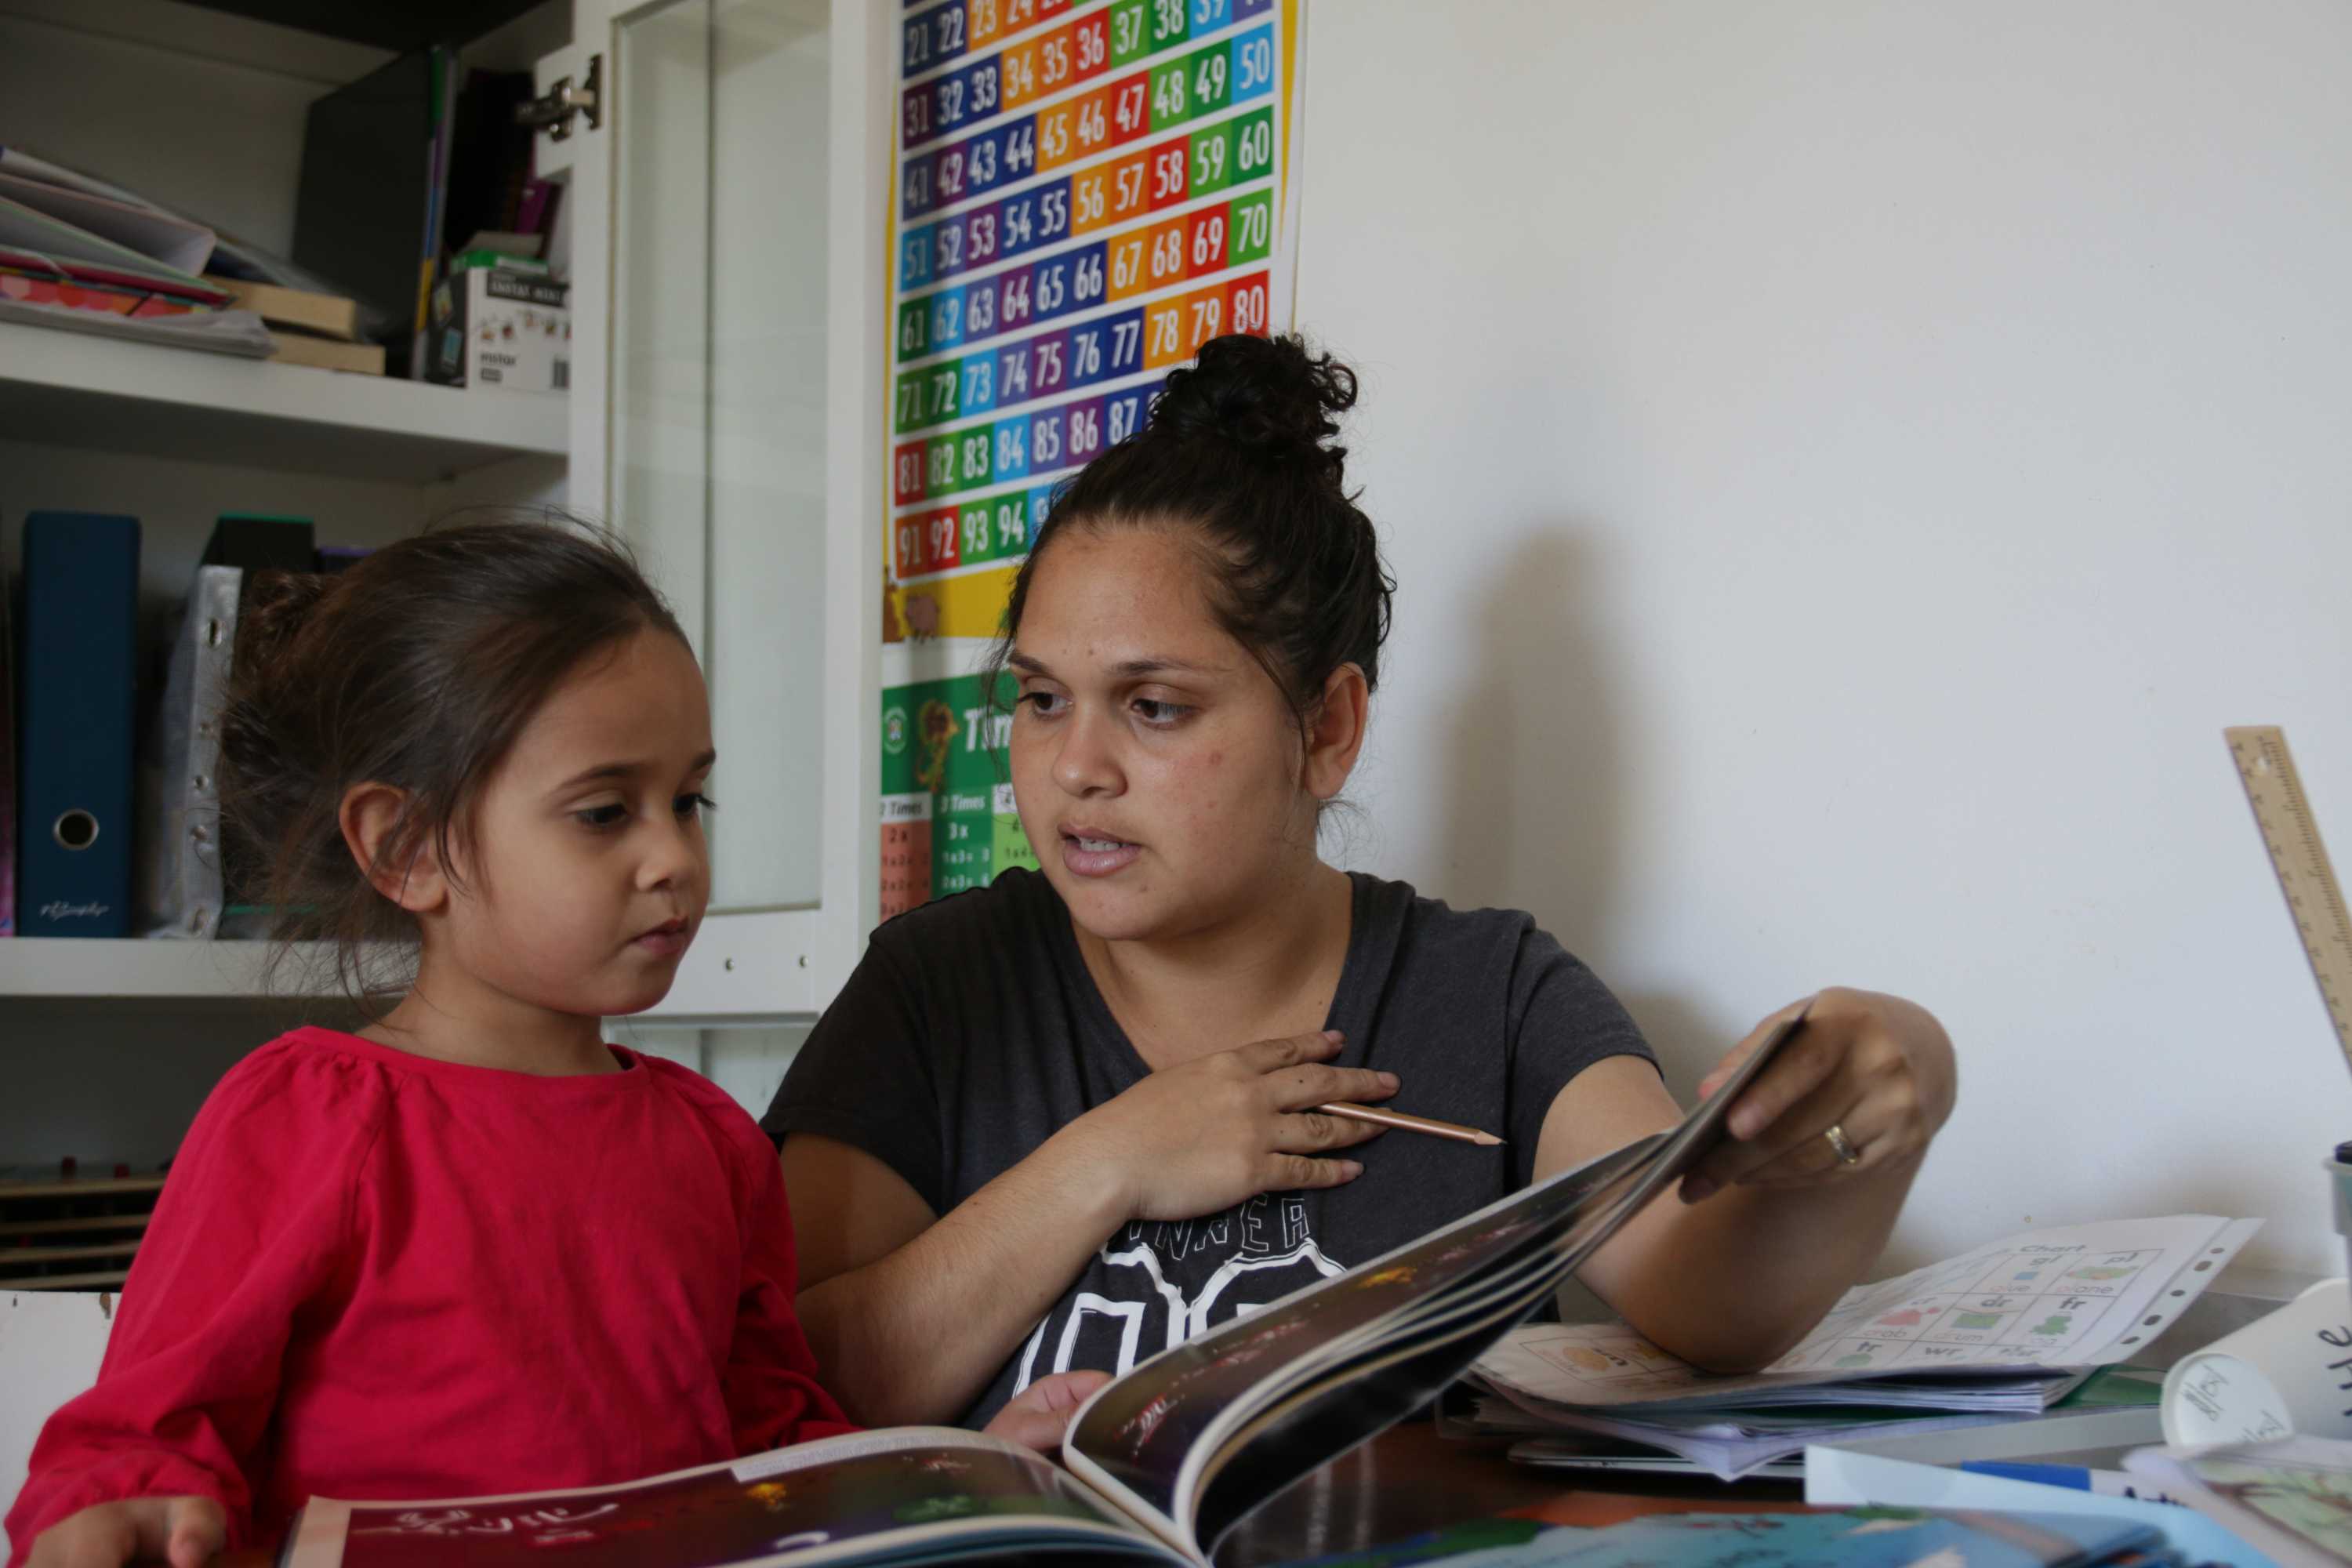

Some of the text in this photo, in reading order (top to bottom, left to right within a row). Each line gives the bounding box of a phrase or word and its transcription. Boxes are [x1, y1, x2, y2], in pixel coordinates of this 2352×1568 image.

[906, 22, 930, 66] 21
[938, 7, 964, 53] 22
[971, 0, 996, 38] 23
[906, 93, 930, 137] 31
[938, 79, 964, 125] 32
[971, 66, 996, 111] 33
[1006, 50, 1033, 98] 34
[1042, 38, 1068, 84] 35
[1076, 21, 1104, 70] 36
[1116, 5, 1143, 55] 37
[1153, 0, 1185, 39] 38
[906, 38, 1270, 207] 41 42 43 44 45 46 47 48 49 50
[906, 120, 1270, 279] 51 52 53 54 55 56 57 58 59 60
[902, 202, 1268, 350] 61 62 63 64 65 66 67 68 69 70
[900, 285, 1265, 422] 71 72 73 74 75 76 77 78 79 80
[898, 451, 920, 495] 81
[929, 443, 954, 487] 82
[963, 434, 989, 480] 83
[997, 424, 1024, 472] 84
[1033, 416, 1060, 463] 85
[1069, 407, 1098, 455] 86
[1108, 397, 1138, 446] 87
[901, 525, 921, 566] 91
[930, 517, 955, 562] 92
[964, 510, 989, 554] 93
[997, 501, 1025, 547] 94
[952, 793, 985, 811] Times
[2020, 1244, 2087, 1253] Chart
[1980, 1294, 2013, 1308] dr
[2059, 1297, 2088, 1309] fr
[1857, 1341, 1882, 1352] tr
